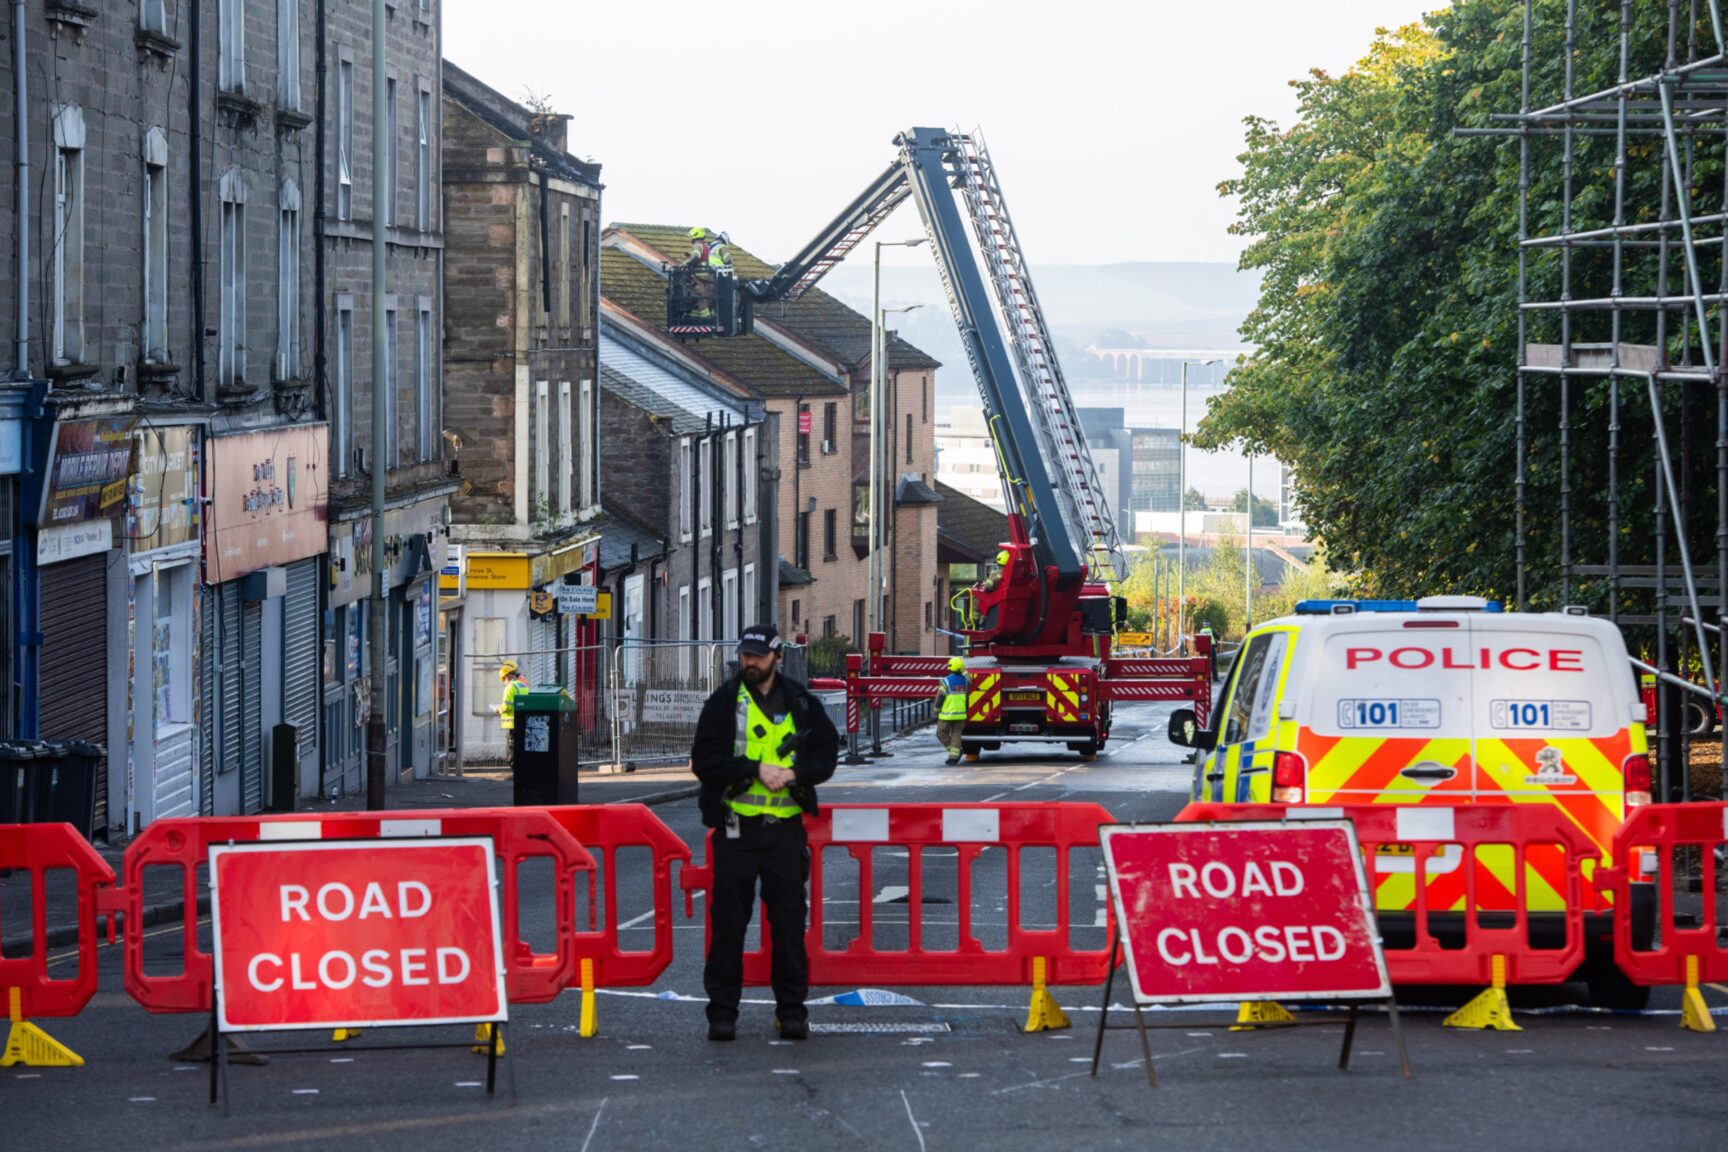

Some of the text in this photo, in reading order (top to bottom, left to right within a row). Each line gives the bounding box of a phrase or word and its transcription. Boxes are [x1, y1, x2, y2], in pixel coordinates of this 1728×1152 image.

[925, 222, 992, 416] SCOTTISH FIRE AND RESCUE SERVICE
[144, 451, 185, 475] CITY MRKET
[744, 633, 766, 642] POLICE
[1346, 647, 1584, 672] POLICE
[1357, 702, 1397, 725] 101
[1510, 703, 1549, 726] 101
[1168, 861, 1305, 899] ROAD
[279, 881, 432, 922] ROAD
[1156, 925, 1347, 966] CLOSED
[247, 946, 471, 992] CLOSED
[864, 991, 892, 1002] CROSS
